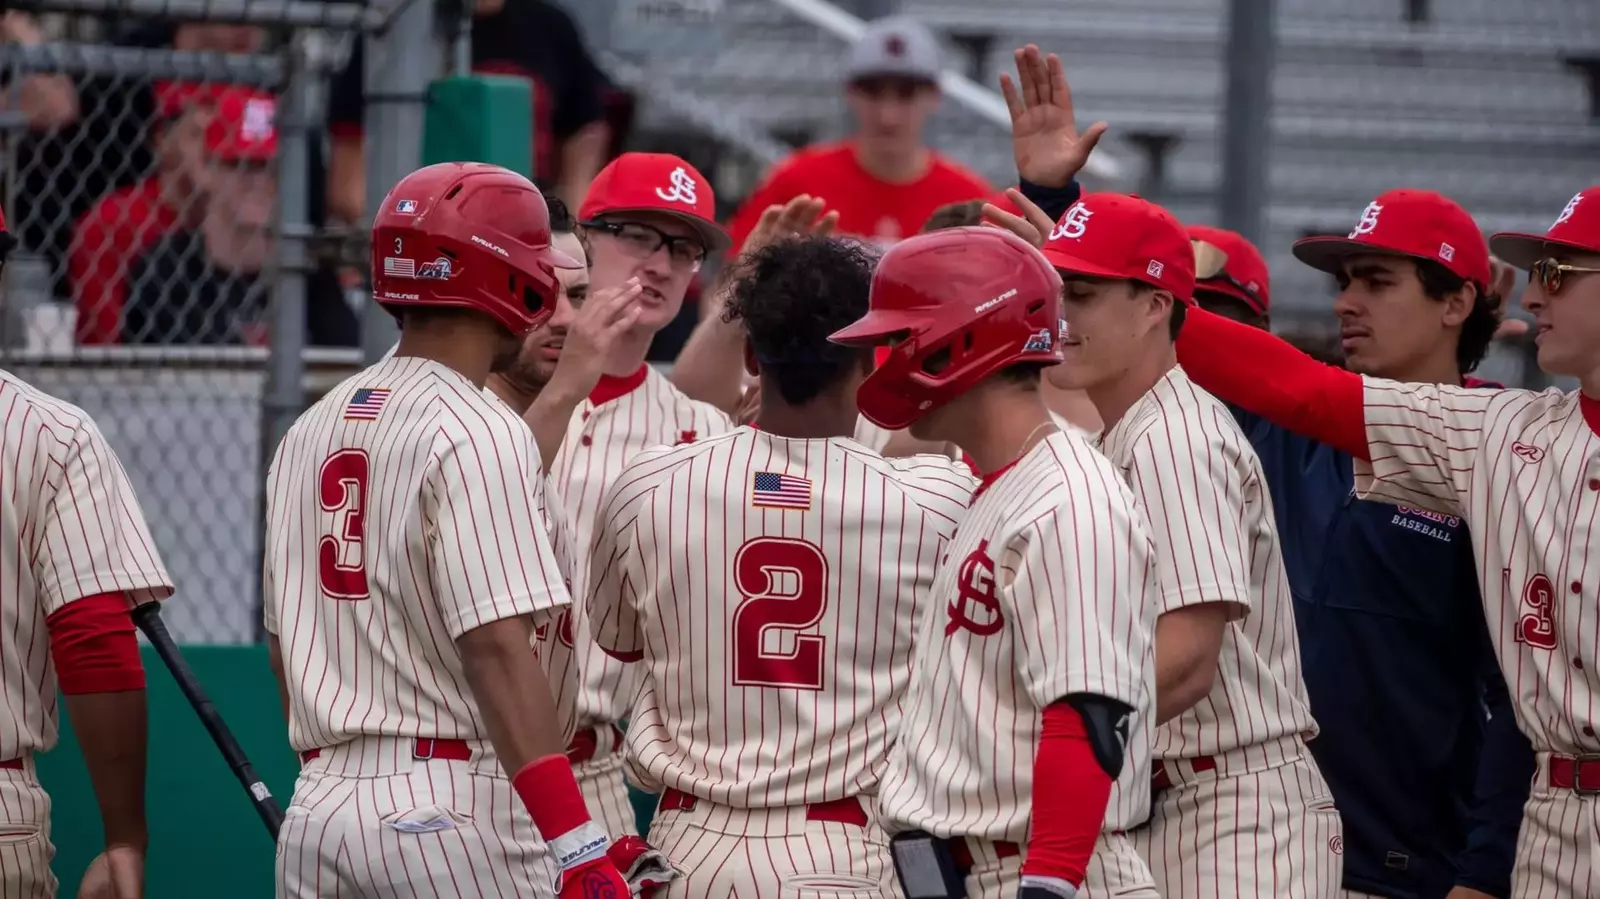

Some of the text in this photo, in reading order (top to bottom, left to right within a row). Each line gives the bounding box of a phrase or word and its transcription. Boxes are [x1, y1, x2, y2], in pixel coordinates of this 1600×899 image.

[394, 237, 403, 254] 3
[318, 448, 370, 600] 3
[1391, 514, 1451, 542] BASEBALL
[732, 536, 829, 691] 2
